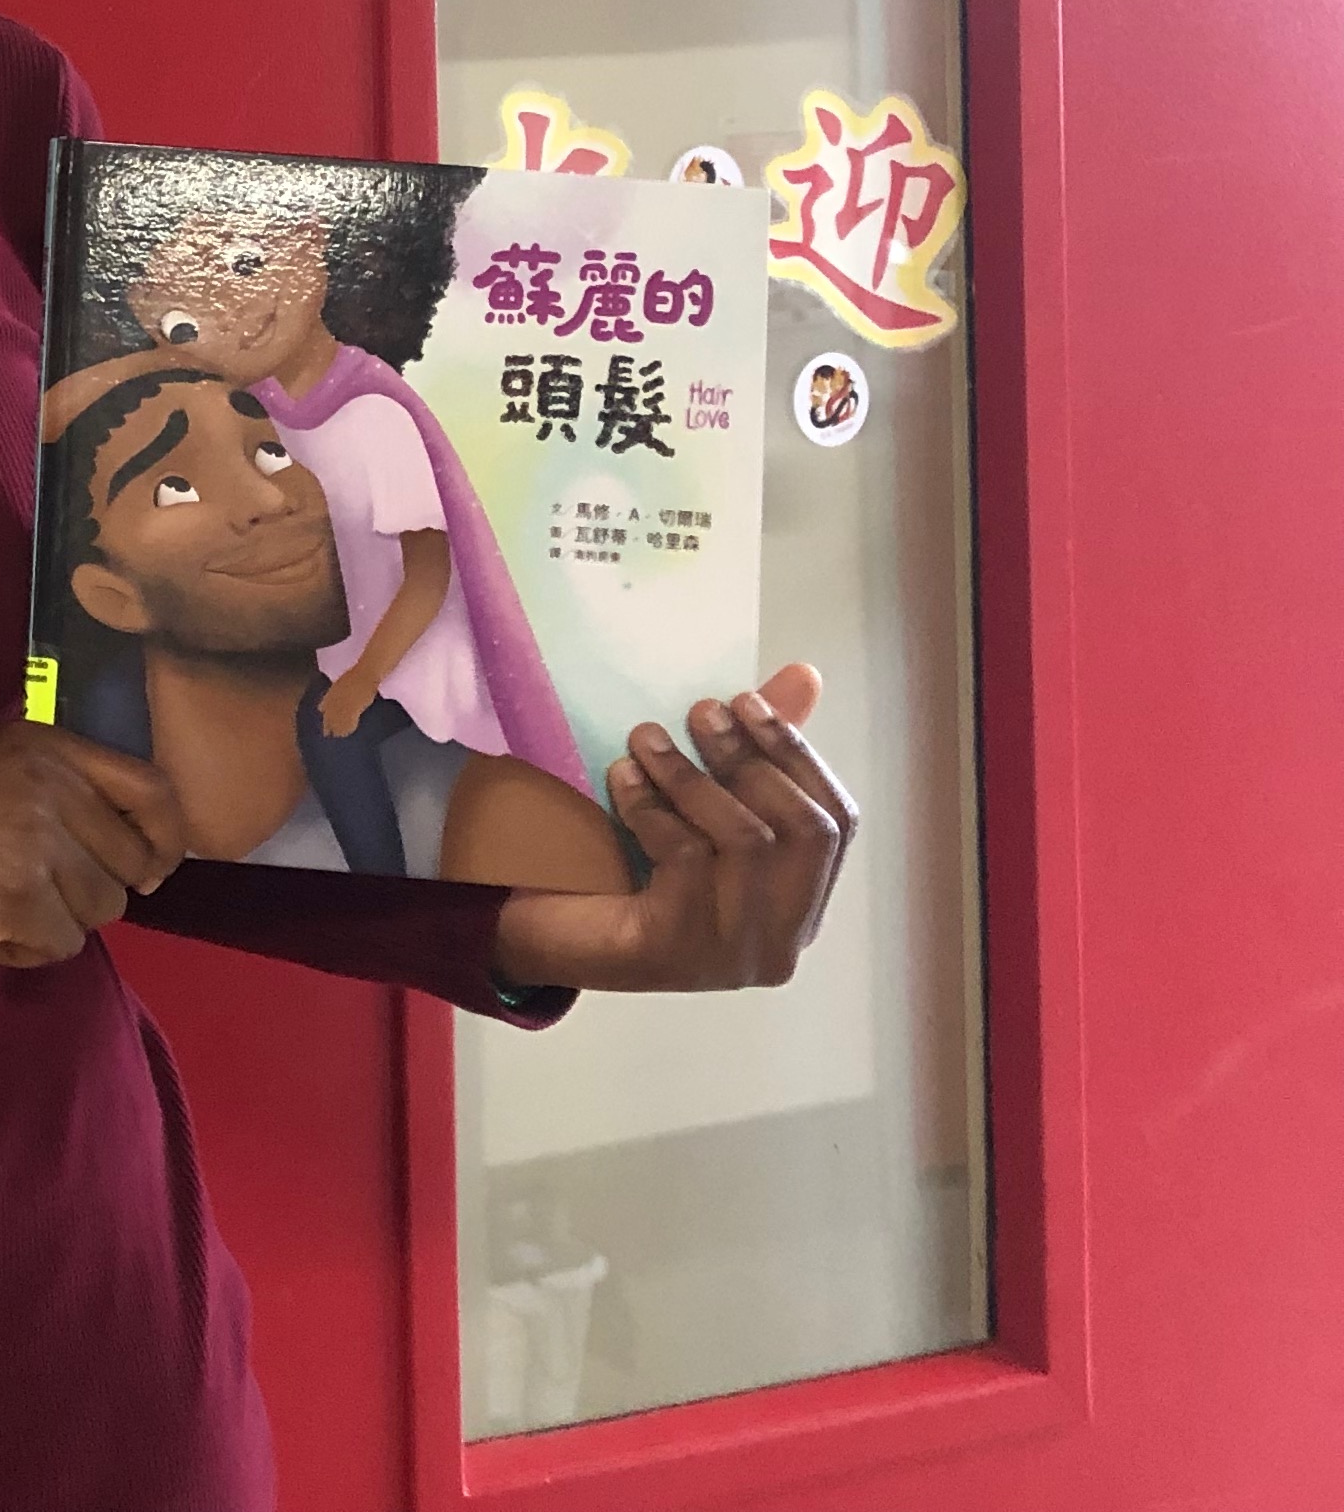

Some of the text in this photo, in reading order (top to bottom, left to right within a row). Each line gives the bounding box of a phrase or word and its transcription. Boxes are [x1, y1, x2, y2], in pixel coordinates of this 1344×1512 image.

[769, 106, 957, 330] 迎
[473, 243, 713, 342] 蘇麗的
[500, 354, 675, 458] 頭髮
[686, 408, 729, 430] Love
[689, 380, 733, 406] Hair
